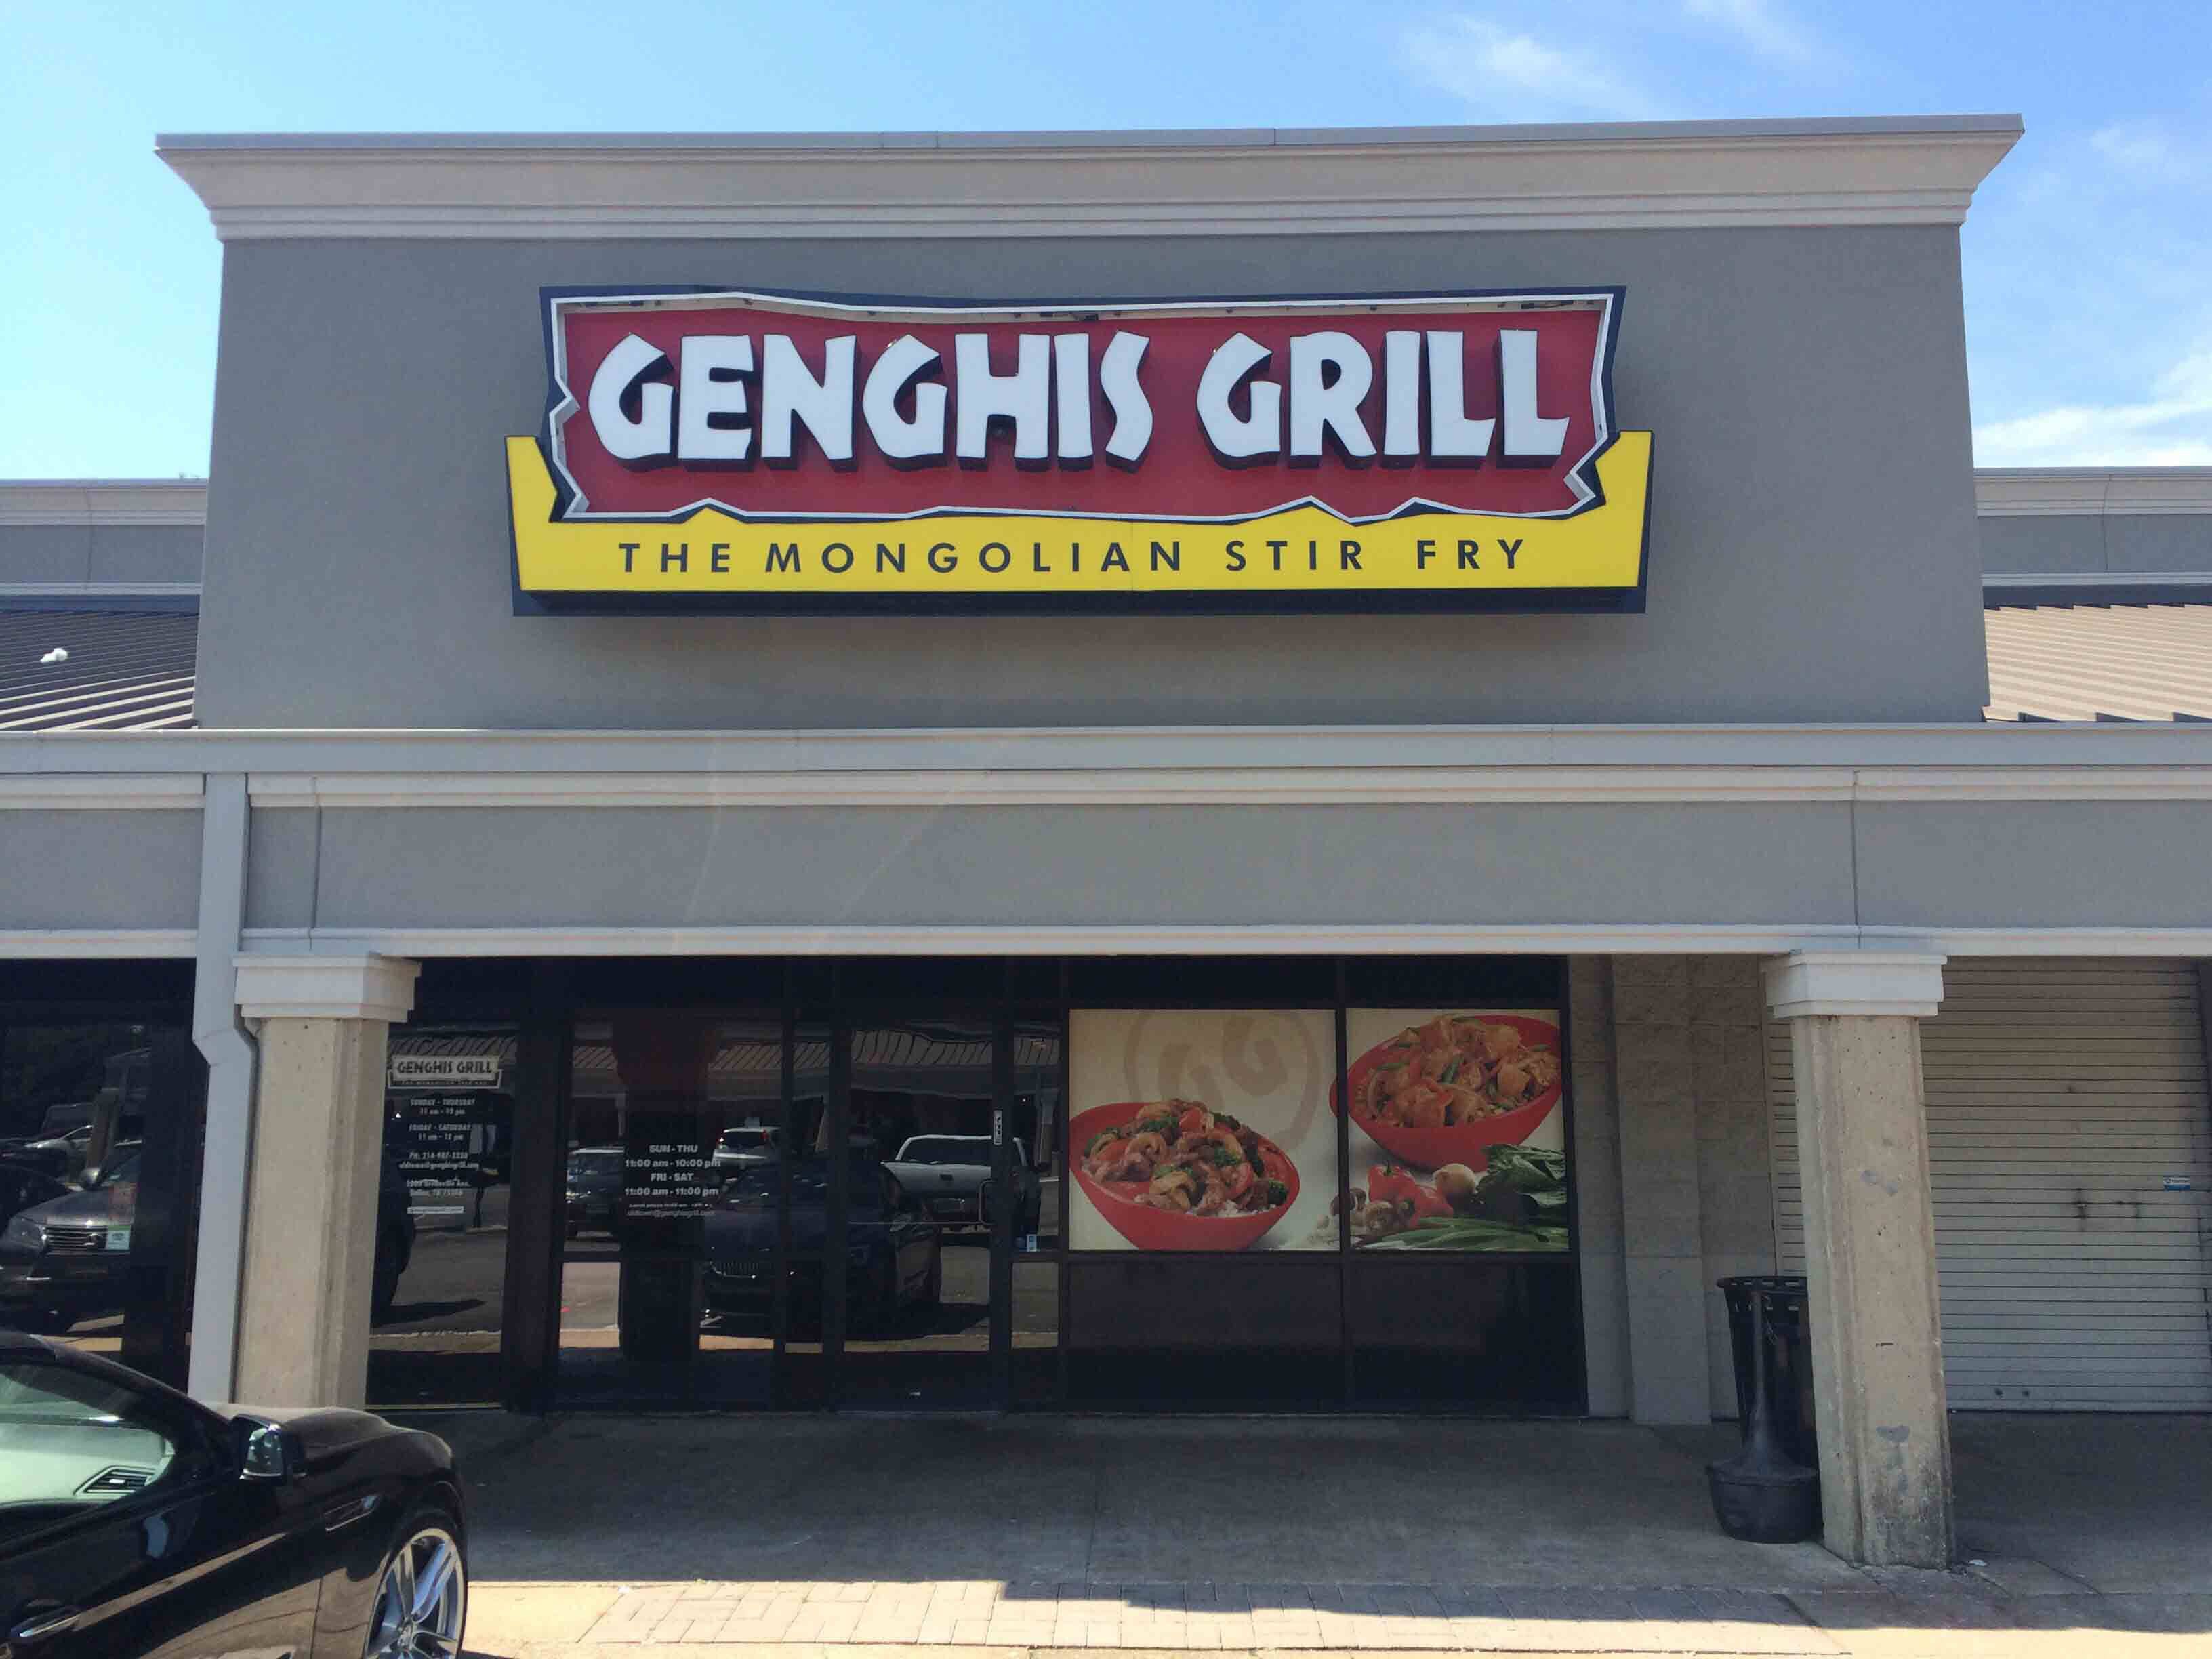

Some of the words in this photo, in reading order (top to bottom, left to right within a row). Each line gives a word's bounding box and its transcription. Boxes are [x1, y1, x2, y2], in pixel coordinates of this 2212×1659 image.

[588, 330, 1153, 468] GENGHIS
[1197, 329, 1570, 465] GRILL
[618, 543, 731, 573] THE
[765, 541, 1181, 574] MONGOLIAN
[1225, 540, 1364, 573] STIR
[1417, 539, 1524, 571] FRY
[397, 1059, 453, 1074] GENGHIS
[457, 1060, 493, 1074] GRILL
[649, 1144, 671, 1153] SUN
[677, 1144, 699, 1153] THU
[625, 1158, 651, 1168] 11:00
[652, 1160, 669, 1168] am
[676, 1158, 703, 1168] 10:00
[704, 1160, 721, 1169] pm
[650, 1172, 668, 1181] FRI
[674, 1172, 694, 1181] SAT
[625, 1187, 651, 1196] 11:00
[652, 1188, 669, 1196] am
[676, 1187, 701, 1196] 11:00
[702, 1188, 719, 1197] pm
